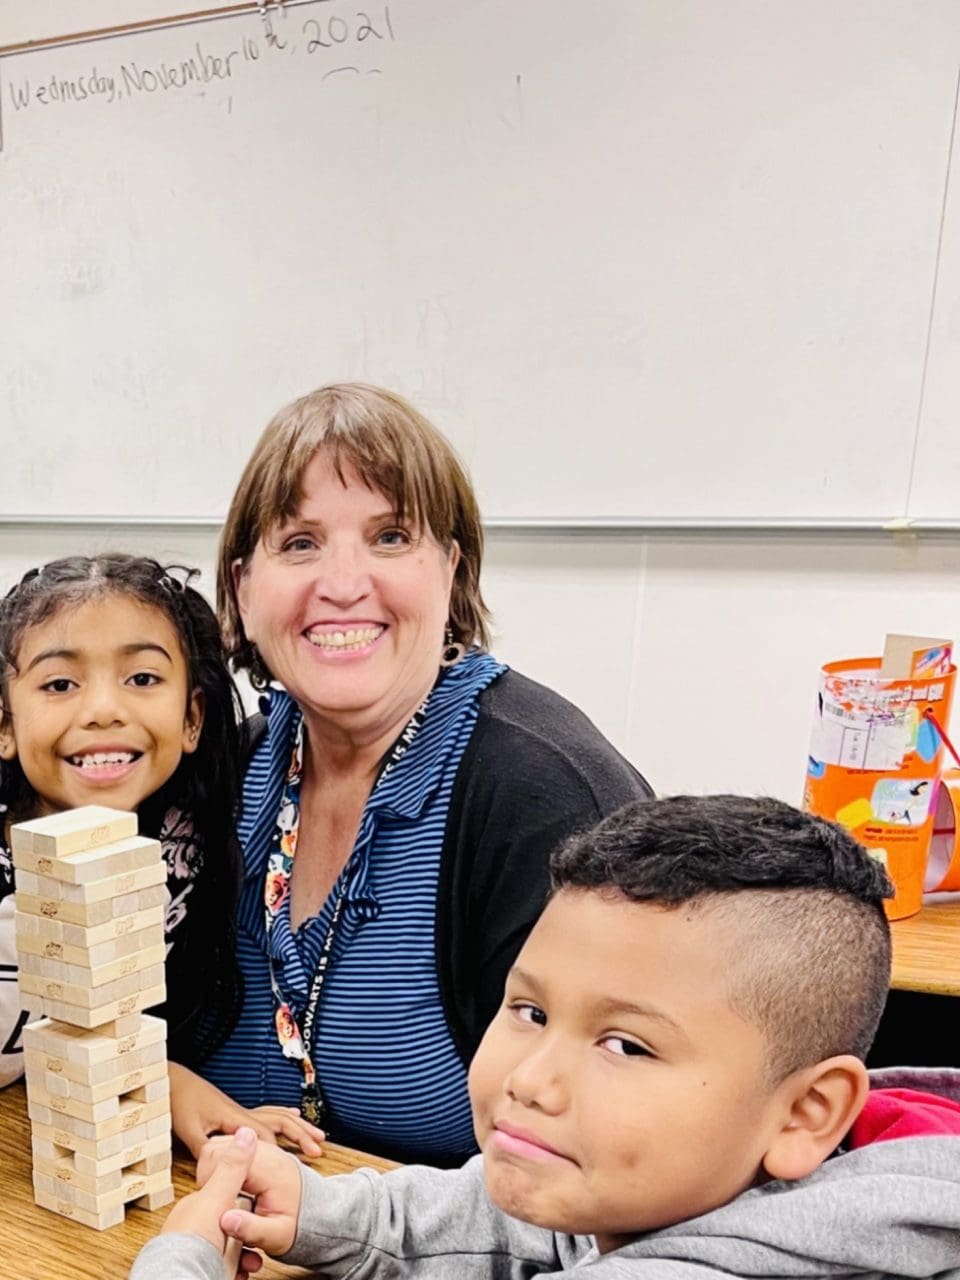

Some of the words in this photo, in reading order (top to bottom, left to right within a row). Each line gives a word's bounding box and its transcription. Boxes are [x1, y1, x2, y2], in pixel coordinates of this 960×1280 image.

[119, 44, 238, 97] November
[302, 5, 395, 54] 2021
[392, 745, 406, 760] IS
[402, 718, 421, 744] MY
[318, 956, 328, 970] IS
